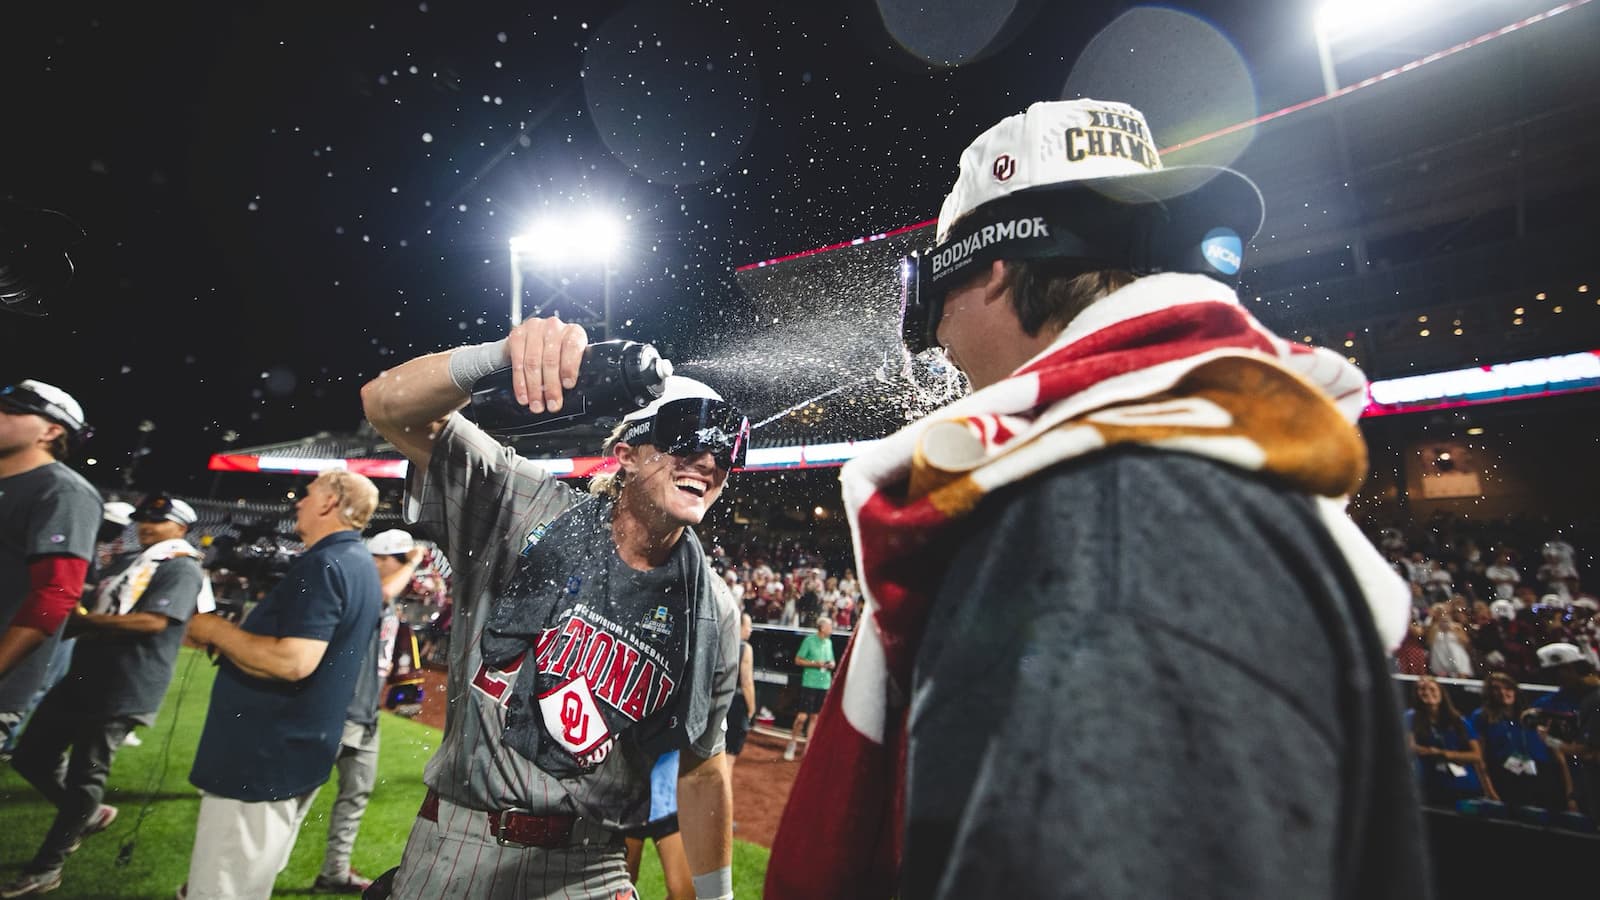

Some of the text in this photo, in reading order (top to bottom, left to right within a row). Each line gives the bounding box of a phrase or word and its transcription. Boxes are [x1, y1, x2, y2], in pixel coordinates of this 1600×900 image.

[993, 154, 1015, 181] OU
[932, 217, 1049, 273] BODYARMOR
[621, 421, 650, 442] ARMOR
[629, 633, 671, 671] BASEBALL
[560, 690, 590, 746] OU
